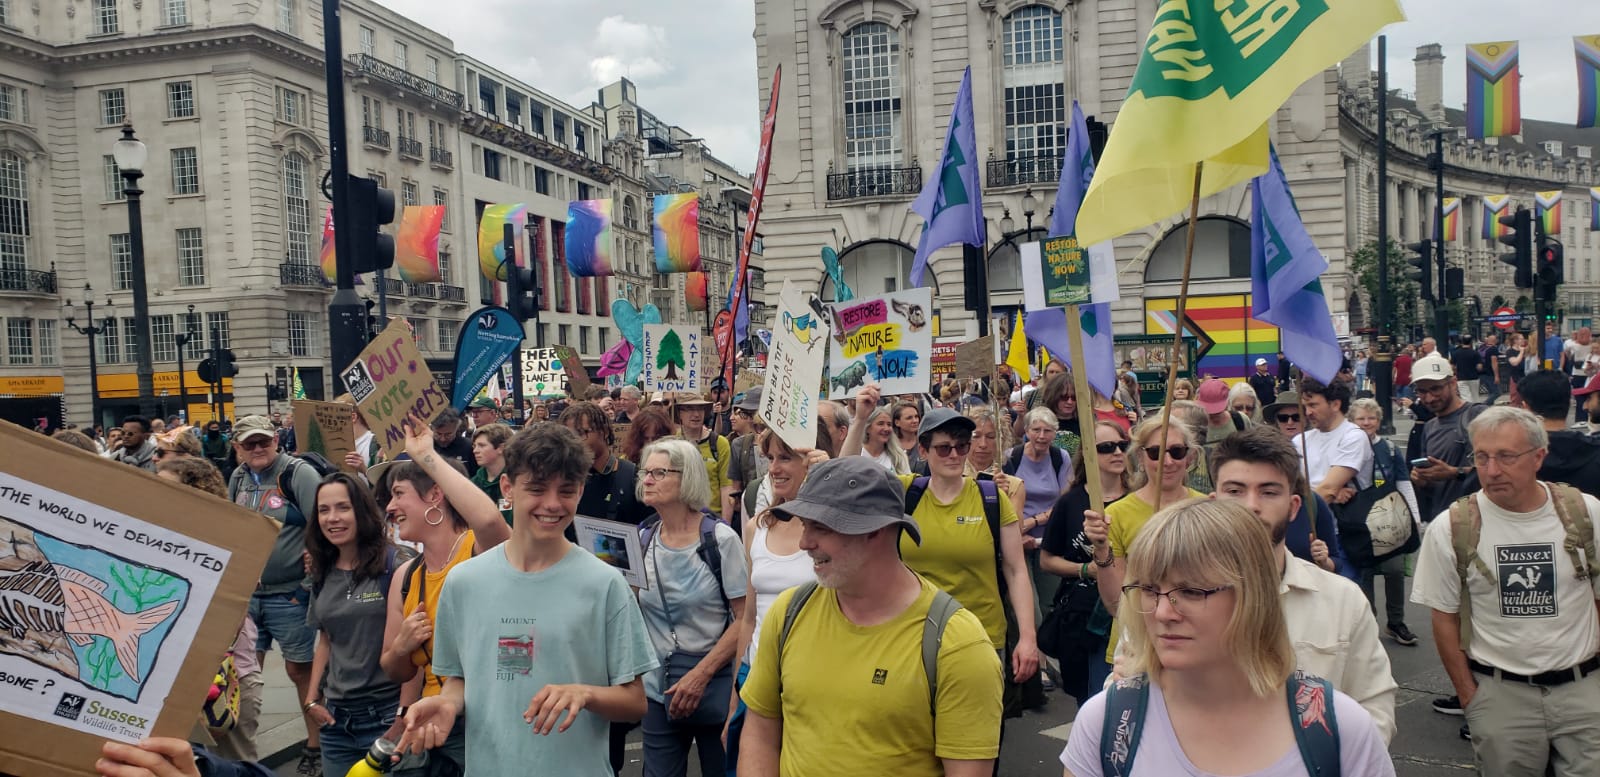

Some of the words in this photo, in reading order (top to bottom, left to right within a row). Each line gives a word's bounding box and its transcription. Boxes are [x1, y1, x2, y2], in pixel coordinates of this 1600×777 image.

[1046, 239, 1078, 251] RESTOR
[1048, 251, 1081, 263] NATURE
[1055, 264, 1076, 275] NOW
[843, 307, 881, 323] RESTORE
[849, 328, 893, 353] NATURE
[689, 333, 698, 388] NATURE
[878, 356, 908, 379] NOW
[463, 352, 507, 402] NOTTINGHAMSHIRE
[771, 374, 778, 388] BE
[657, 381, 685, 391] NOW
[776, 352, 794, 430] RESTORE
[789, 382, 802, 428] NATURE
[799, 390, 809, 430] NOW
[1, 486, 32, 505] THE
[38, 499, 87, 525] WORLD
[93, 517, 119, 536] WE
[124, 529, 223, 572] DEVASTATED
[1500, 549, 1552, 562] Sussex
[1503, 590, 1553, 606] wildlife
[1504, 605, 1554, 615] TRUSTS
[501, 617, 537, 625] MOUNT
[496, 672, 514, 682] FUJI
[86, 700, 150, 729] Sussex
[82, 715, 118, 733] Wildlife
[119, 726, 143, 739] Trust
